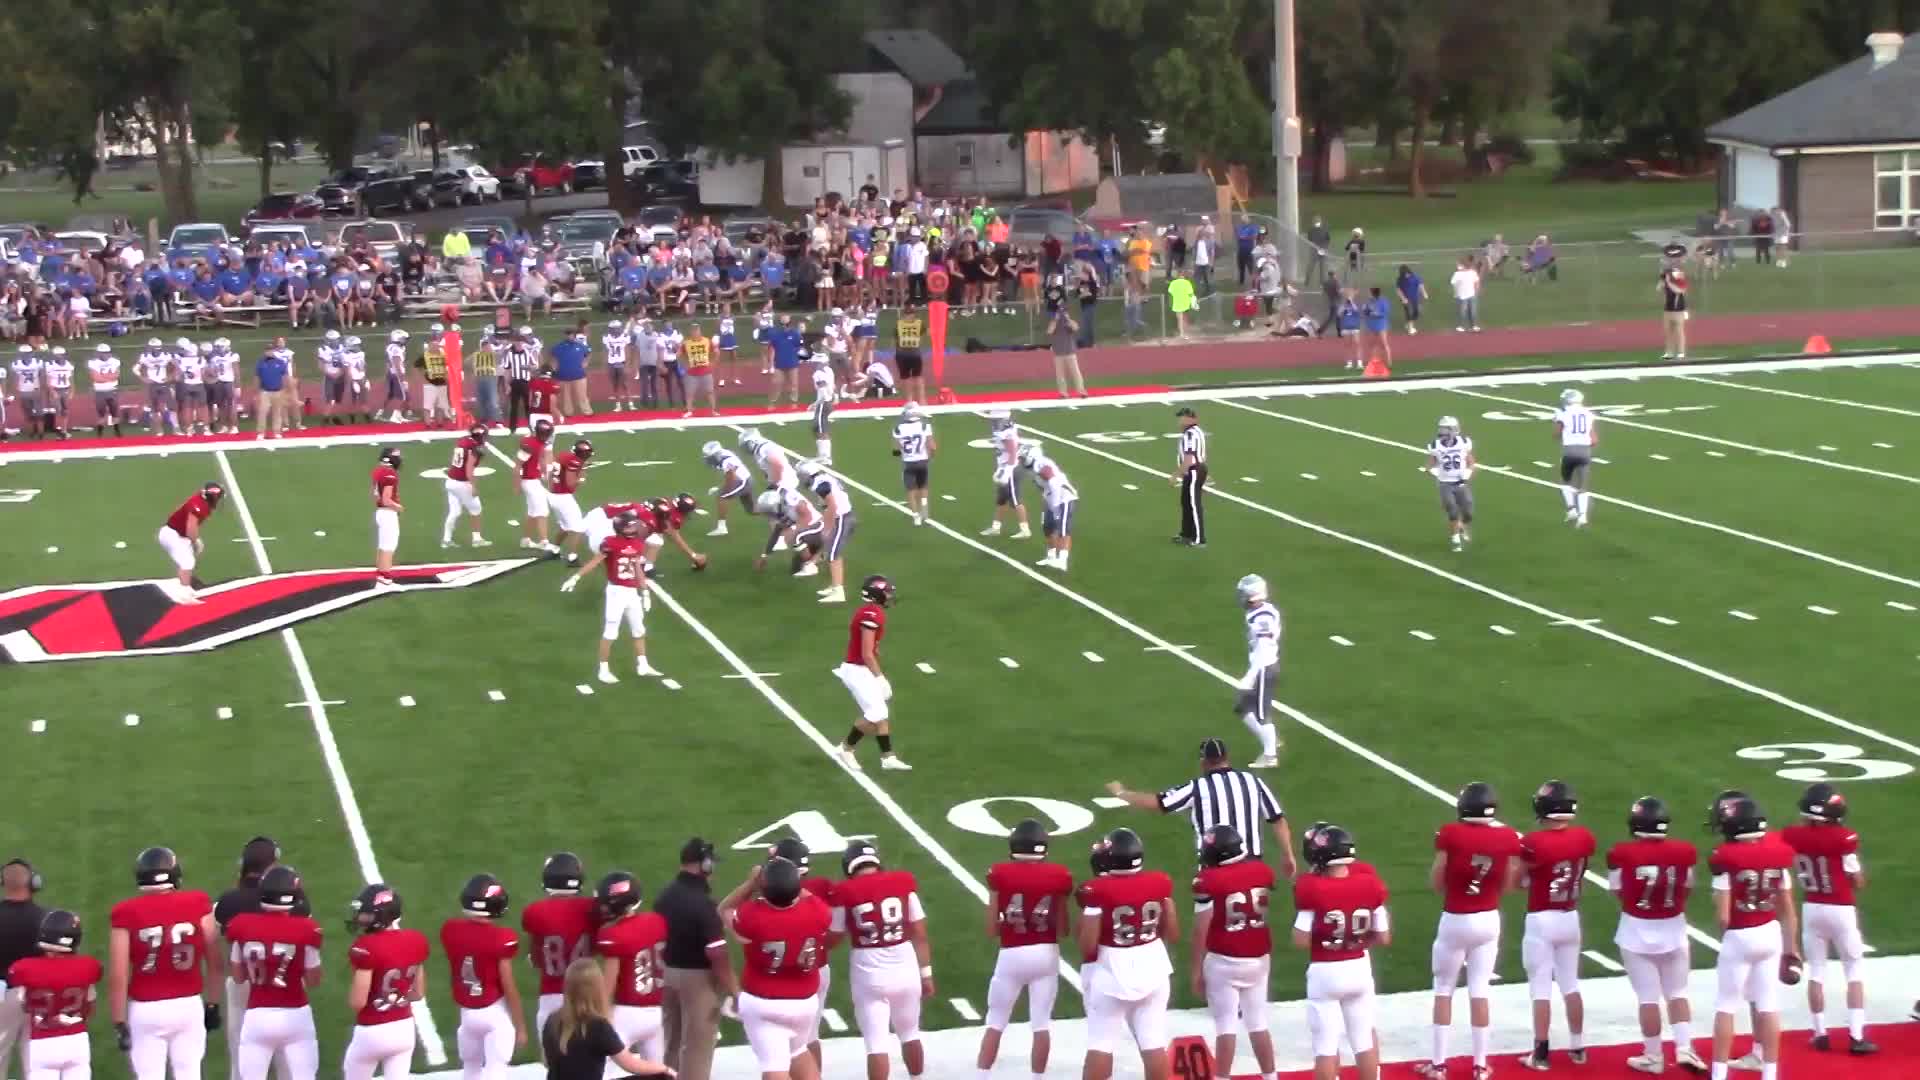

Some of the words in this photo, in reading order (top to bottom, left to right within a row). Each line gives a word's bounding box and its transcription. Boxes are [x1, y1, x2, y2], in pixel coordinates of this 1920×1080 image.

[902, 434, 922, 453] 27
[1571, 413, 1587, 435] 10
[1465, 853, 1493, 895] 7
[1549, 857, 1587, 903] 21
[1635, 865, 1676, 910] 71
[1005, 892, 1053, 934] 44
[138, 921, 196, 973] 76
[460, 955, 483, 997] 4
[1172, 1043, 1211, 1080] 40
